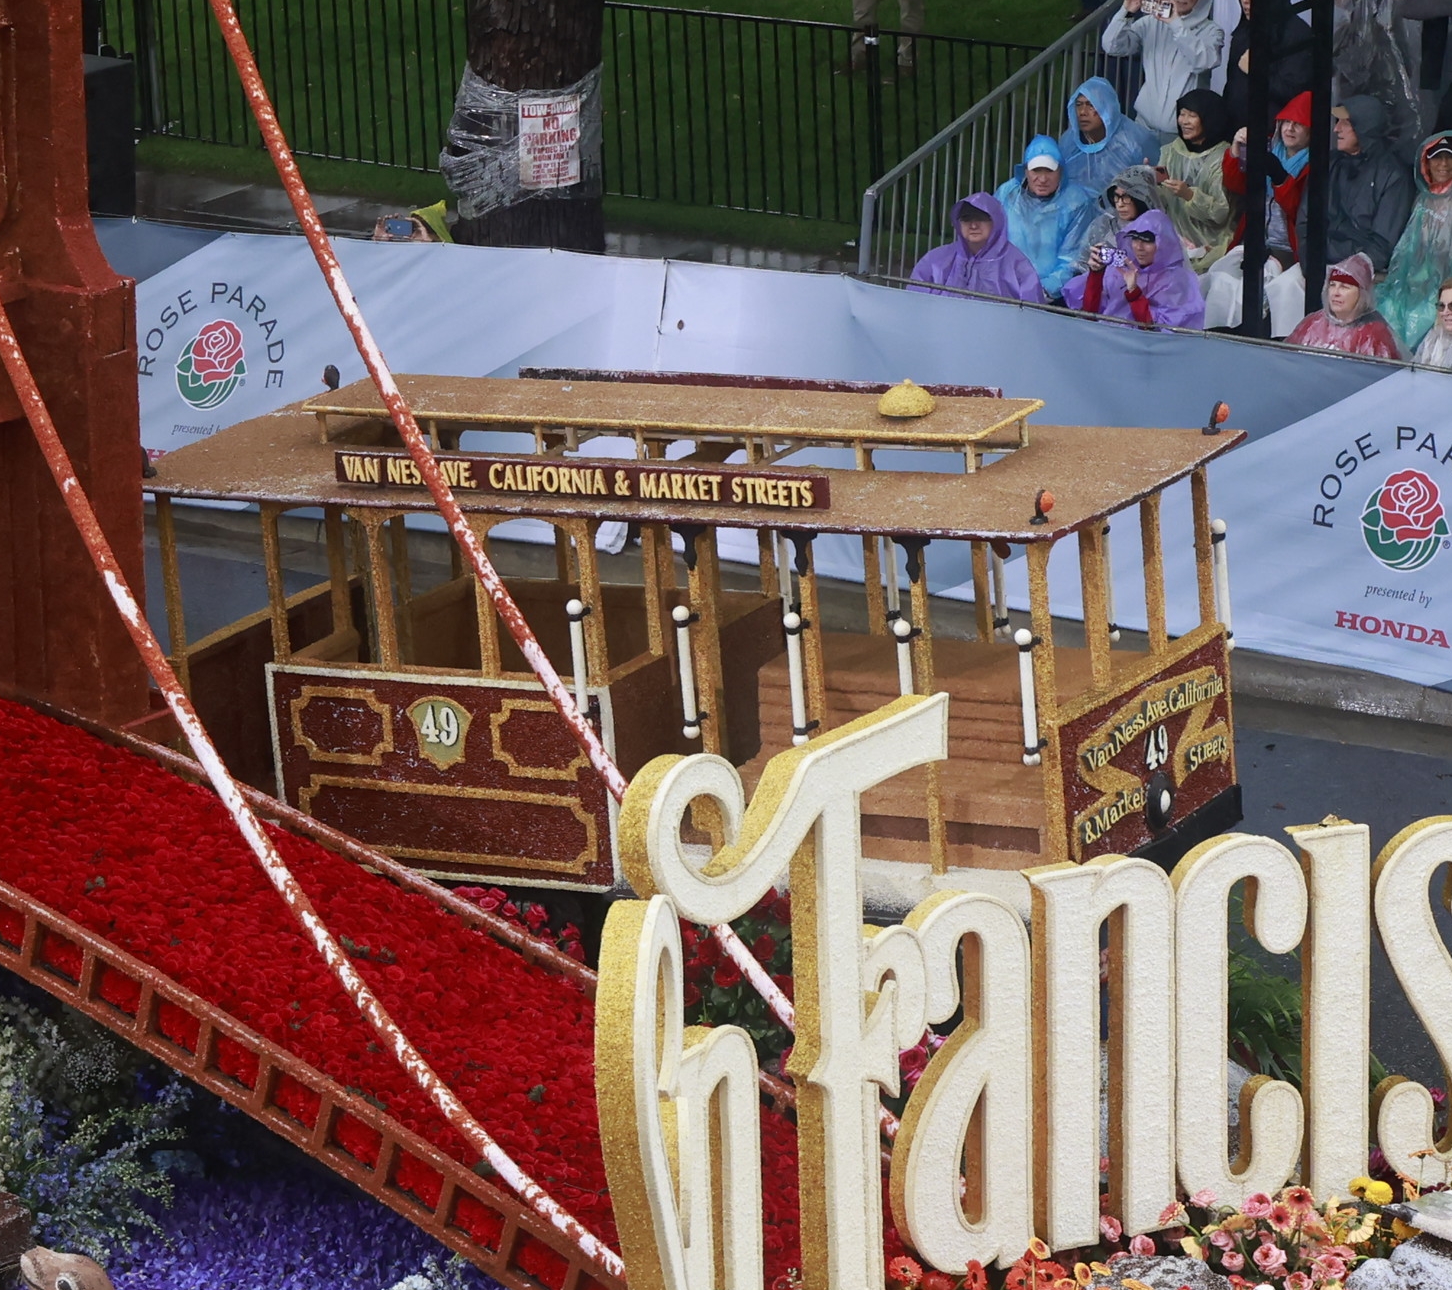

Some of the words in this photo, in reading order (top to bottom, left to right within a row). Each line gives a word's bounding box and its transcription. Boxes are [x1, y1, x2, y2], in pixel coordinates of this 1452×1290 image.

[521, 127, 576, 146] PARKING
[542, 117, 560, 131] NO
[138, 290, 197, 377] ROSE
[211, 282, 284, 389] PARADE
[171, 424, 214, 436] presented
[342, 455, 379, 484] VAN
[386, 458, 426, 486] NES
[489, 463, 607, 496] CALIFORNIA
[614, 469, 631, 496] &
[639, 472, 721, 502] MARKET
[731, 476, 814, 508] STREETS
[1313, 432, 1380, 529] ROSE
[1364, 584, 1415, 602] presented
[1418, 591, 1432, 608] by
[1334, 610, 1450, 649] HONDA
[420, 704, 459, 747] 49
[1086, 745, 1116, 772] Van
[1114, 713, 1146, 753] Ness
[1169, 675, 1224, 713] California
[1146, 724, 1169, 771] 49
[1189, 735, 1228, 772] Streets
[1085, 820, 1094, 845] &
[1095, 789, 1147, 839] Market
